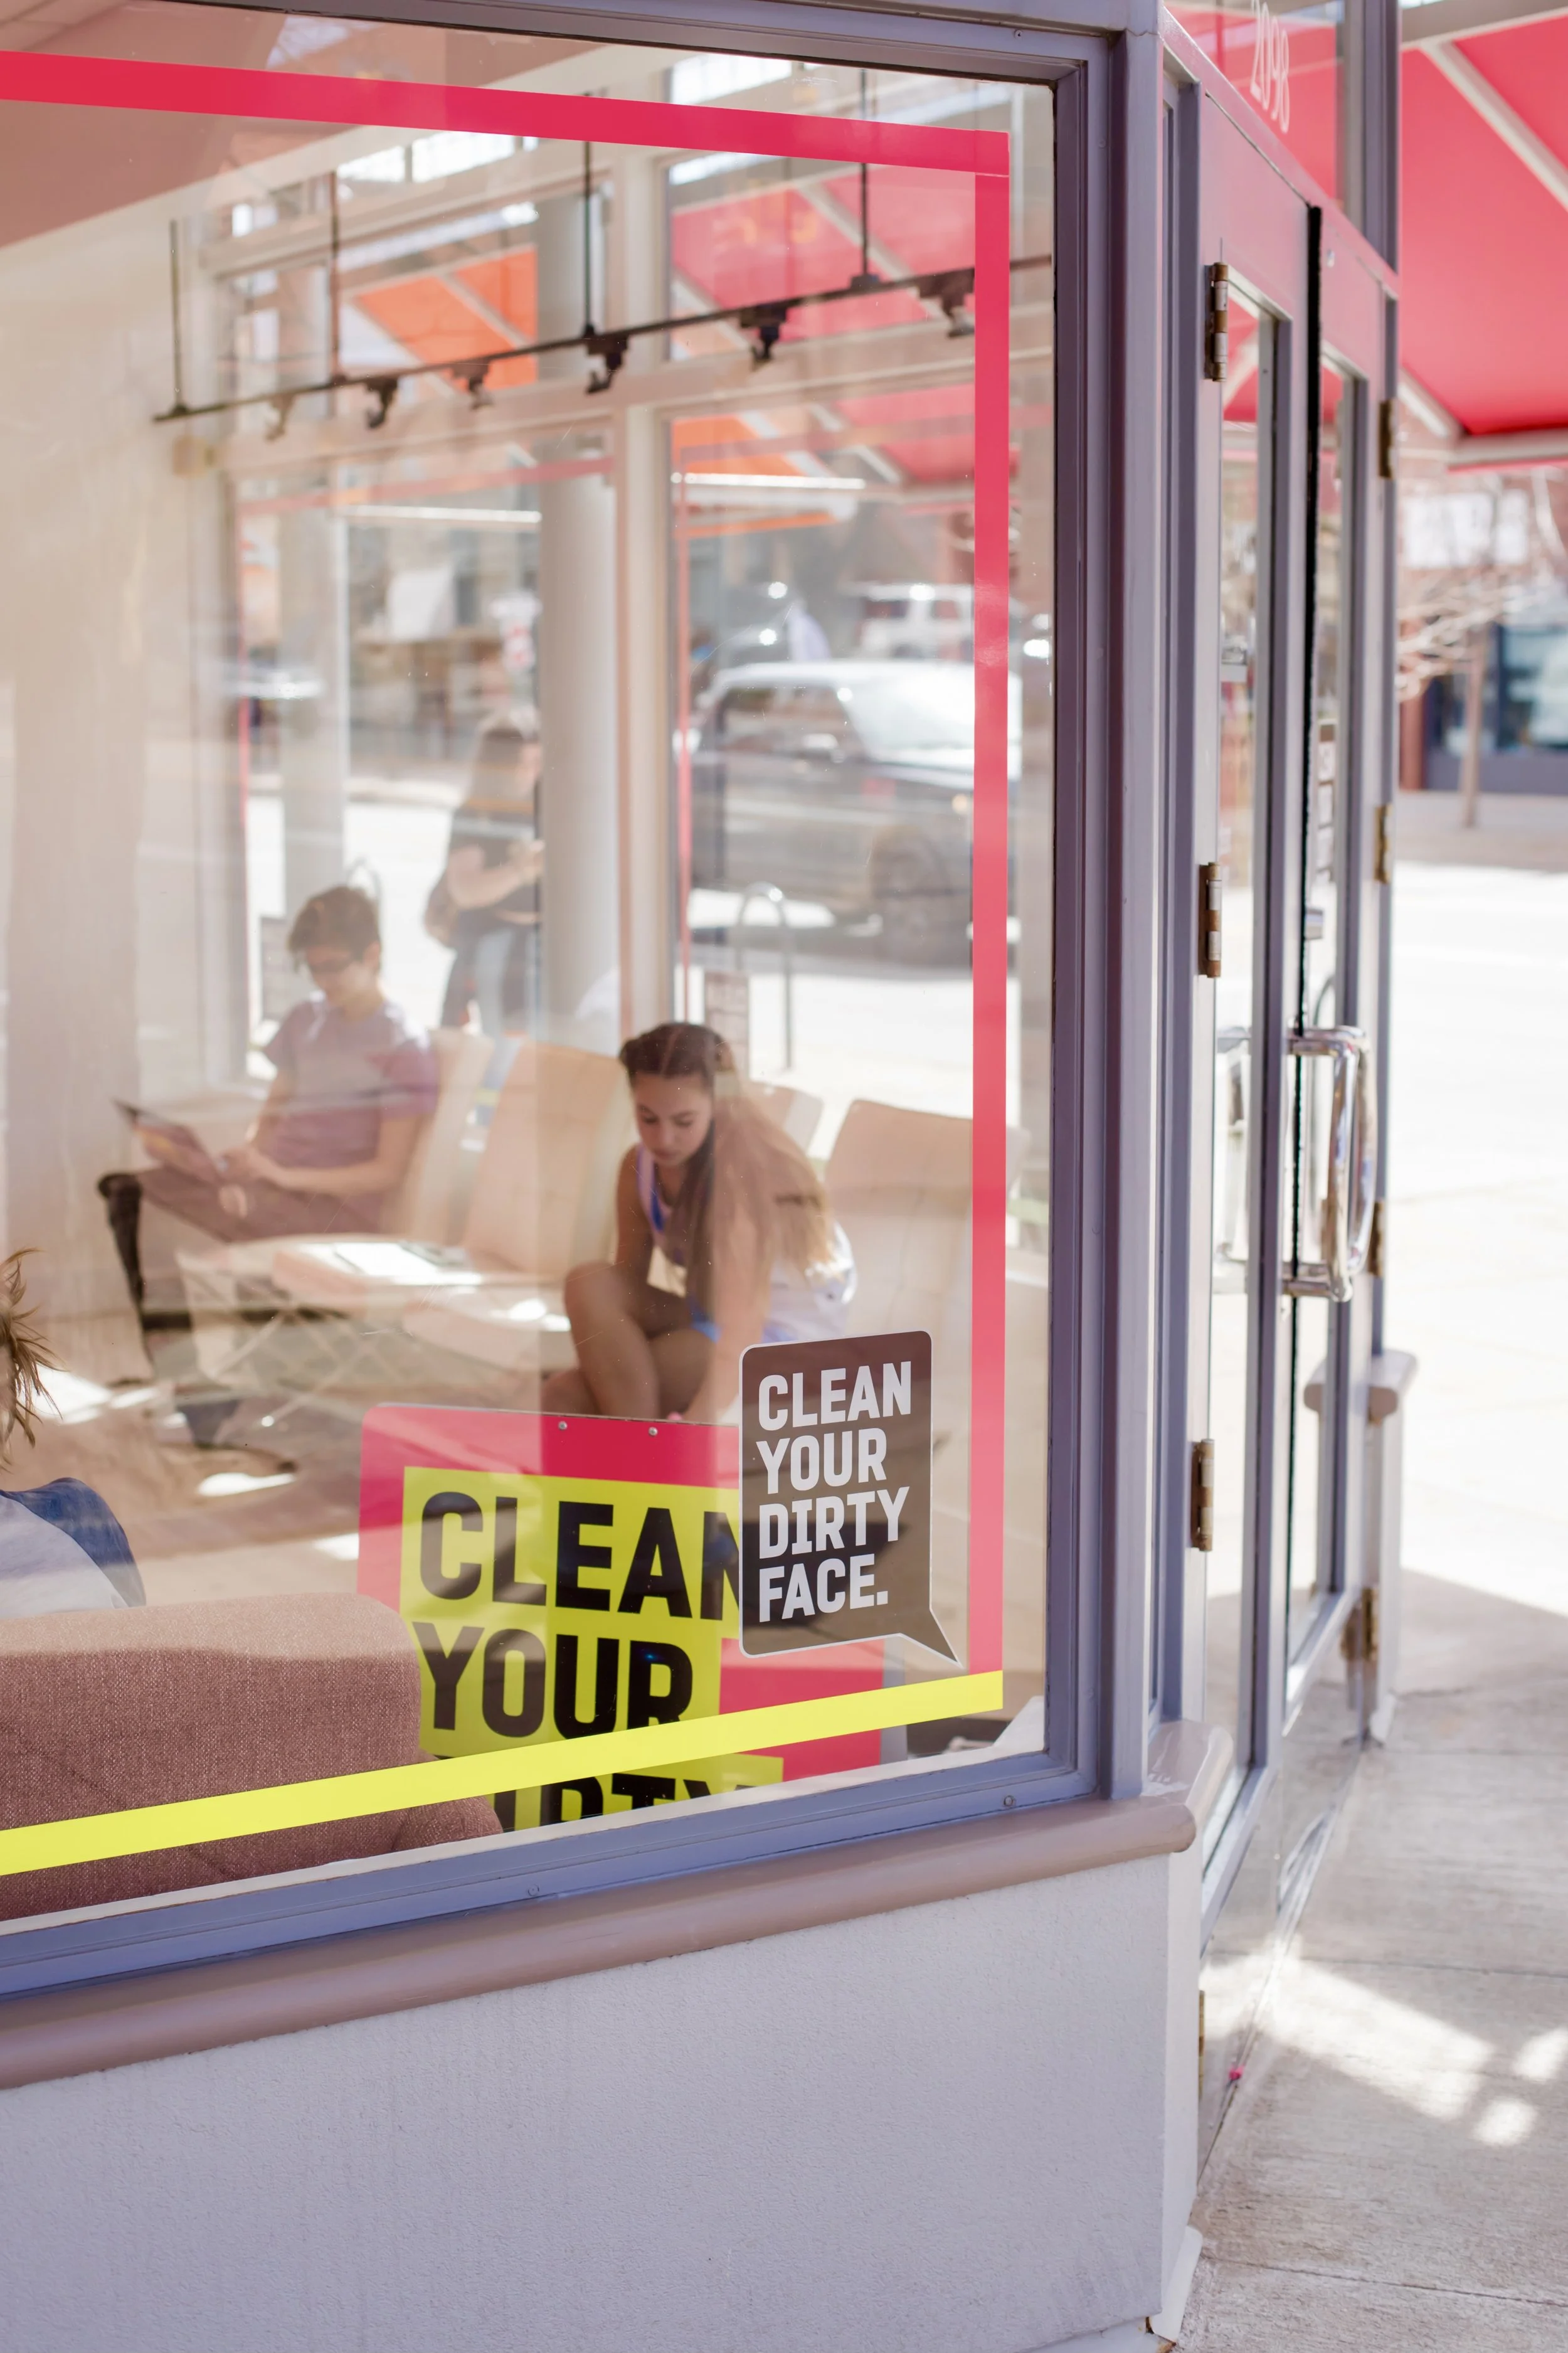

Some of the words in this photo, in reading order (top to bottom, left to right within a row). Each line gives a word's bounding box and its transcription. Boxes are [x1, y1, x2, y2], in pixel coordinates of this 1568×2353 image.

[1250, 0, 1290, 134] 2098
[758, 1361, 911, 1431] CLEAN
[756, 1428, 887, 1494] YOUR
[760, 1486, 910, 1559] DIRTY
[760, 1553, 888, 1622] FACE.
[412, 1621, 692, 1740] YOUR
